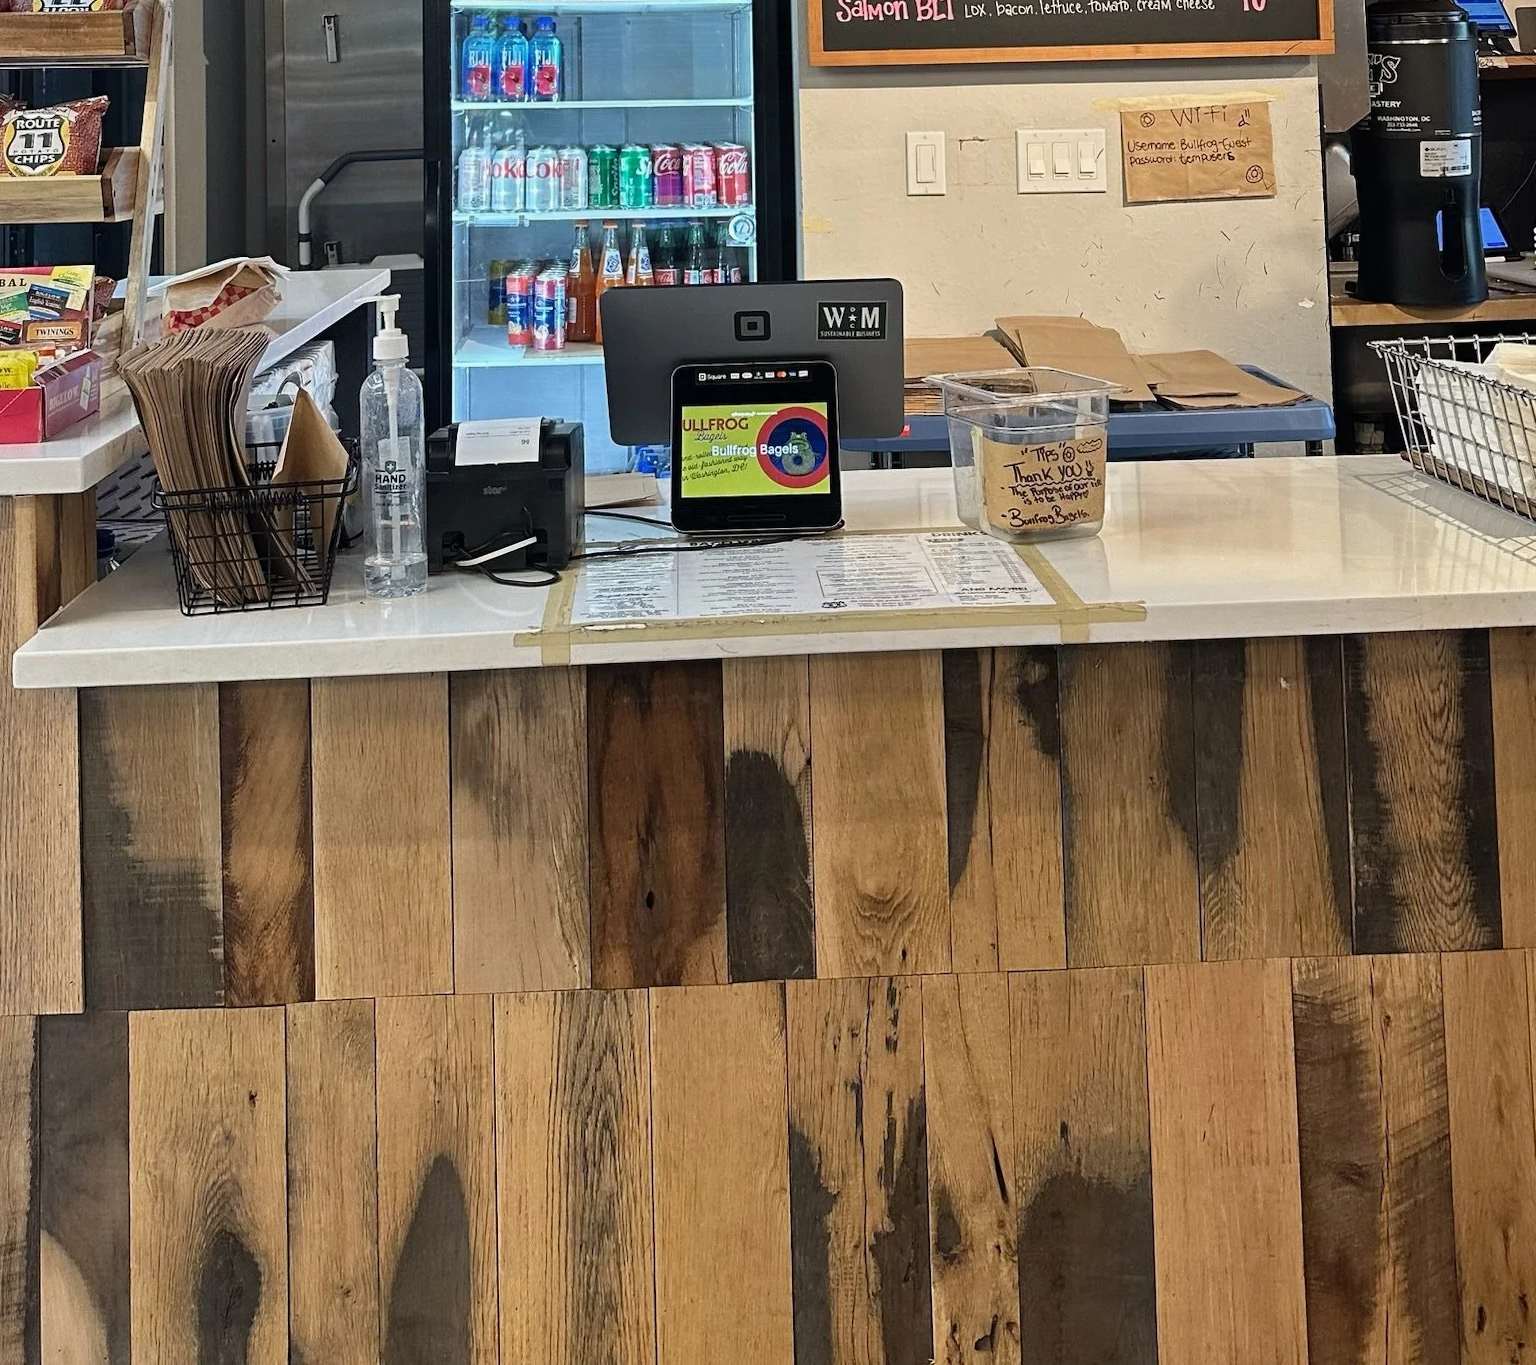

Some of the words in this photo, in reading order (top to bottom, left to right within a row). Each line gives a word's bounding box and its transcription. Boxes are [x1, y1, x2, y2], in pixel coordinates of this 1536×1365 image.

[17, 119, 60, 129] ROUTE
[19, 133, 53, 148] 11
[14, 155, 55, 163] CHIPS
[719, 152, 747, 175] Cola
[682, 418, 748, 431] ULLFROG
[711, 445, 756, 457] Bullfrog
[760, 443, 798, 454] Bagels
[376, 475, 405, 483] HAND
